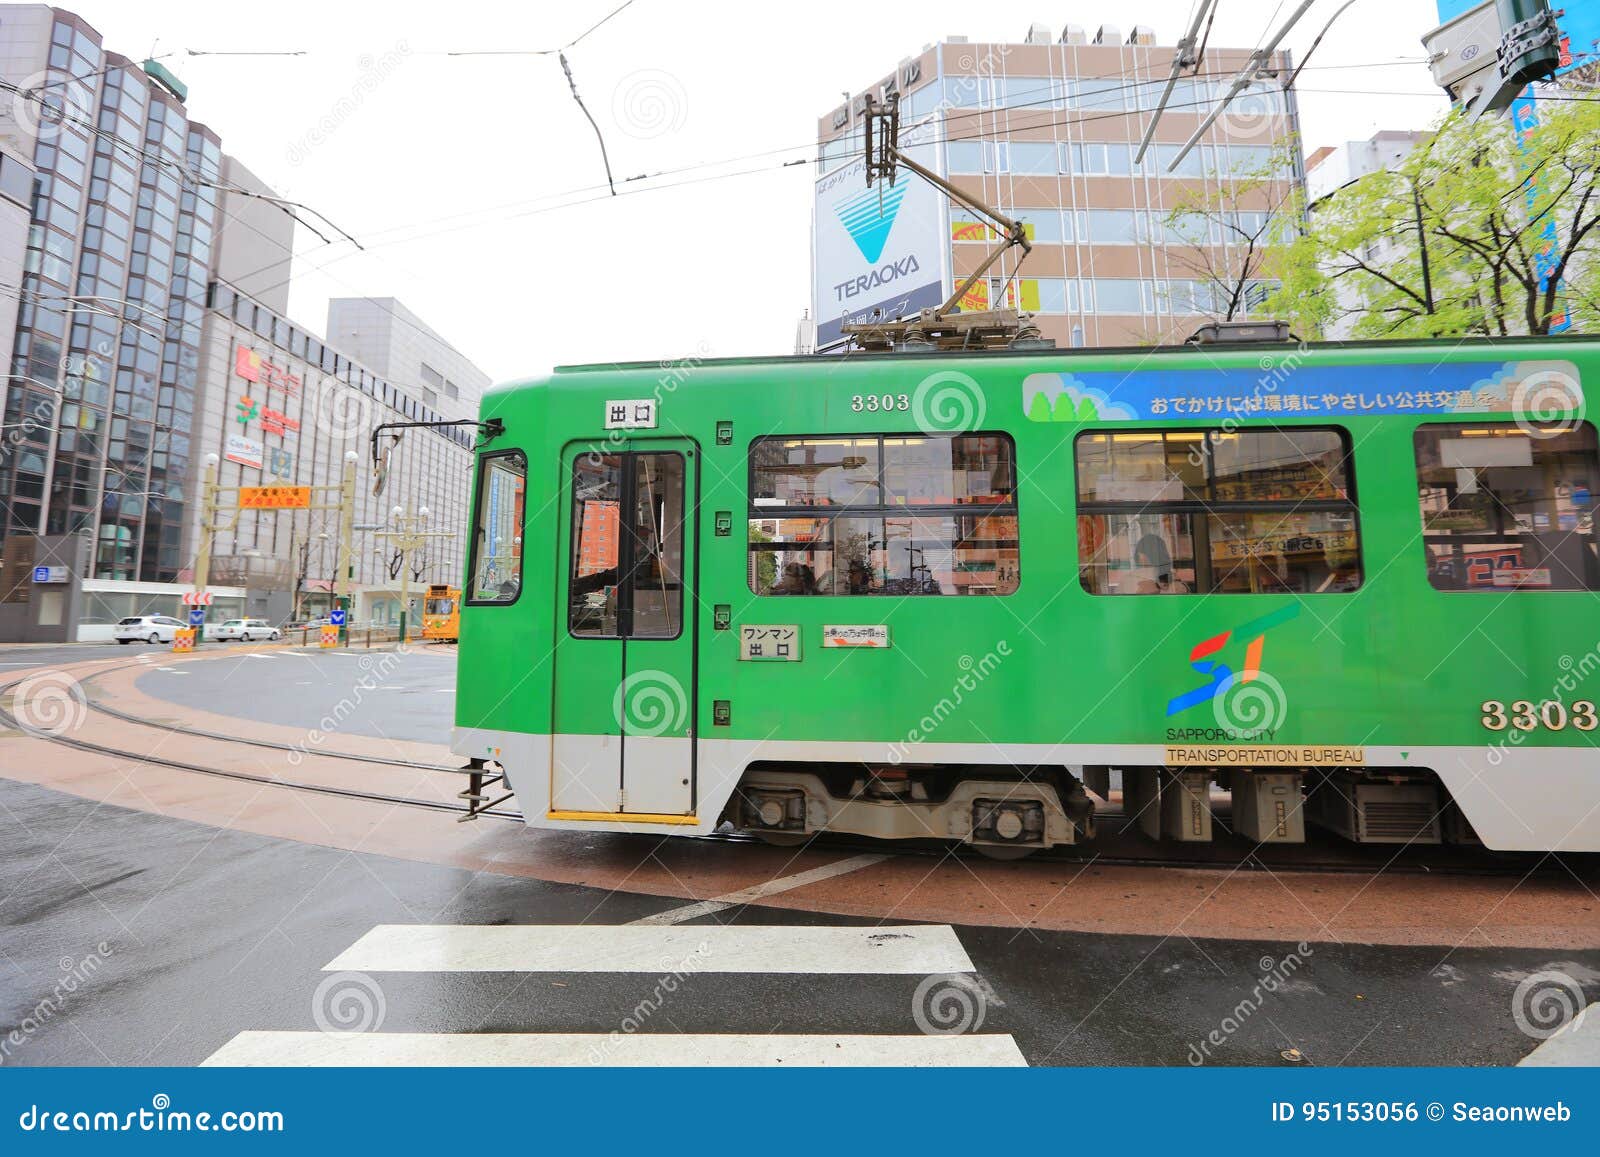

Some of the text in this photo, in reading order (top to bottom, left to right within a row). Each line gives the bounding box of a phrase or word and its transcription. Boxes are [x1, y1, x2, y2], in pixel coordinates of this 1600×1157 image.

[834, 254, 920, 302] TERAOKA
[851, 394, 909, 412] 3303
[610, 405, 649, 423] 出口
[744, 628, 794, 640] ワンマン
[750, 643, 789, 656] 出口
[1481, 700, 1599, 731] 3303
[1167, 728, 1276, 741] SAPPORO CITY
[1168, 749, 1364, 763] TRANSPORTATION BUREAU
